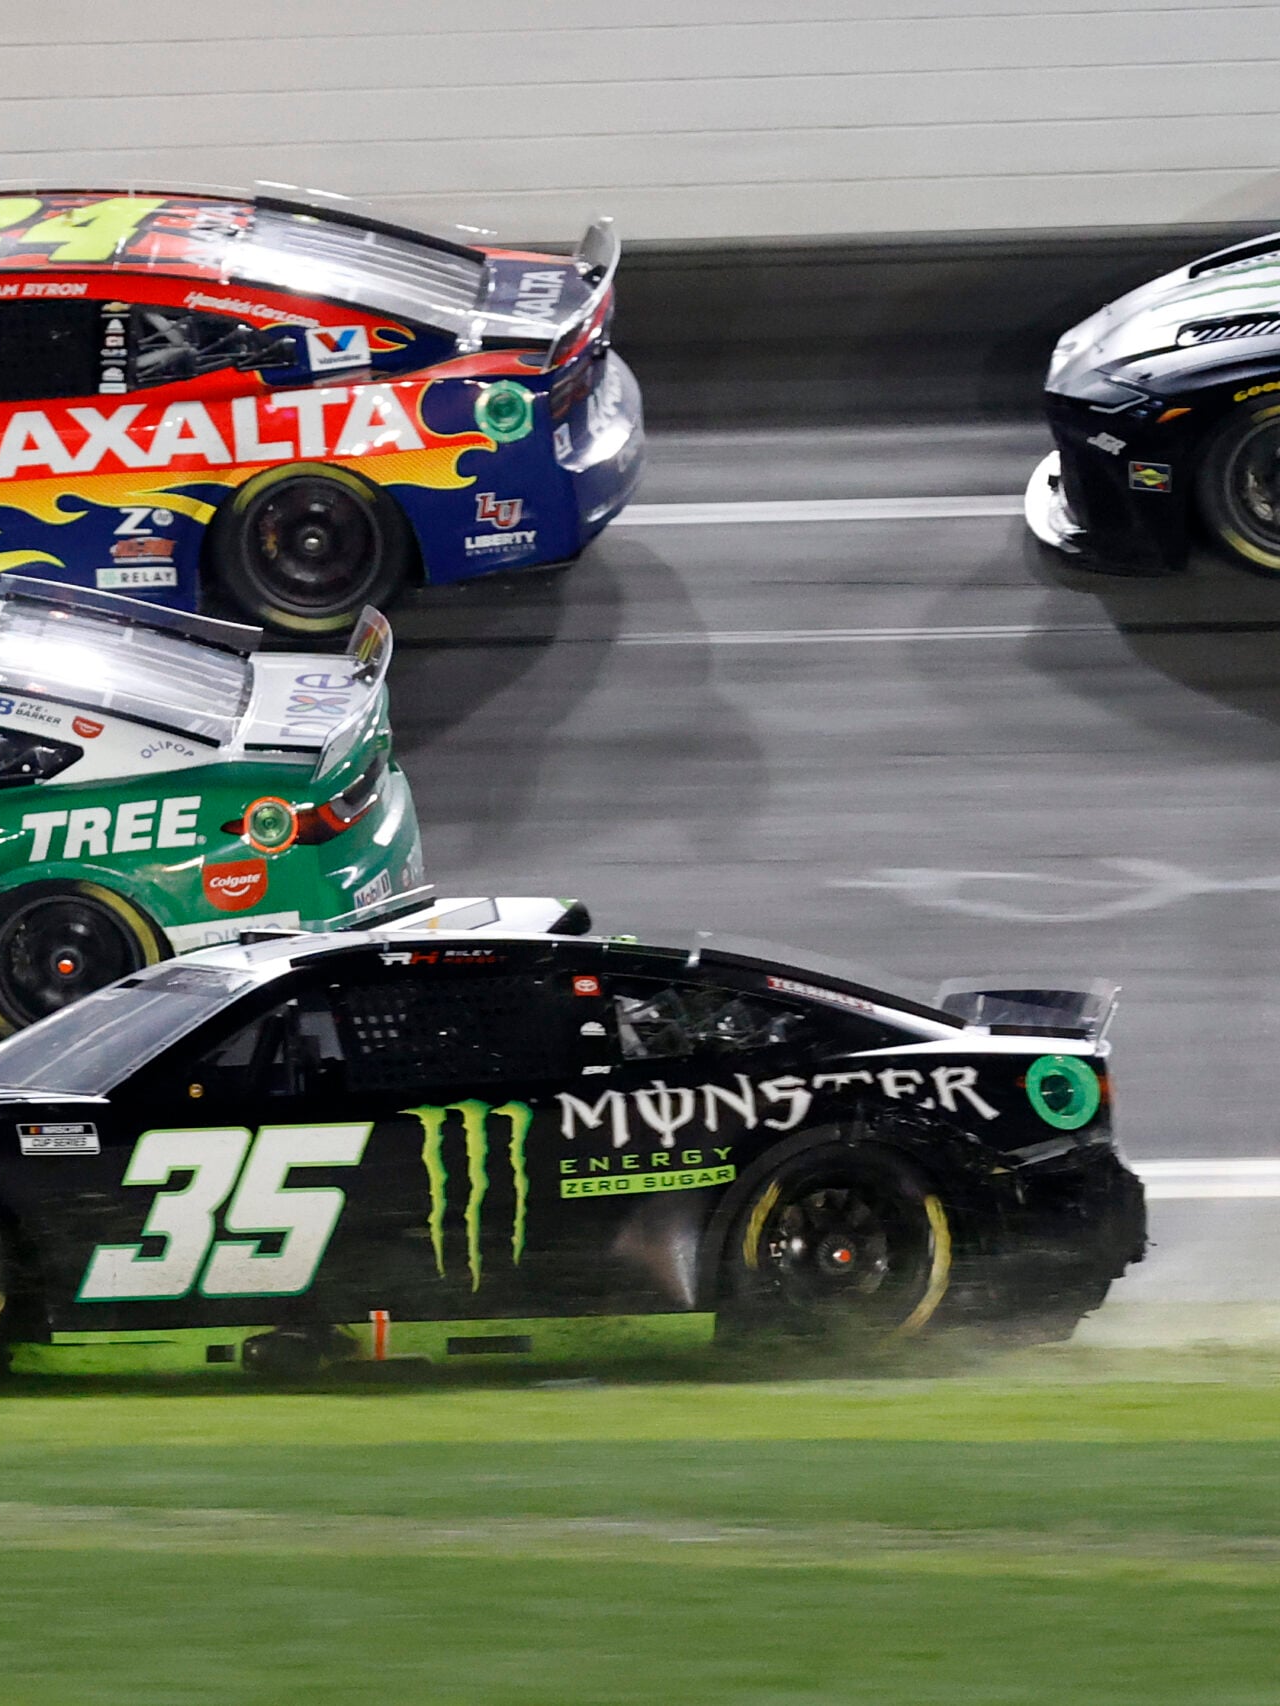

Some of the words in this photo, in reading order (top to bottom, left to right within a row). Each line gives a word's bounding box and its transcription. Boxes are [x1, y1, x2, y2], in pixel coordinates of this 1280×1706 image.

[21, 283, 89, 297] BYRON
[465, 531, 537, 550] LIBERTY
[120, 572, 172, 583] RELAY
[15, 708, 62, 725] BARKER
[140, 741, 195, 760] OLIPOP
[22, 796, 202, 862] TREE
[209, 873, 262, 889] Colgate
[53, 1137, 88, 1147] SERIES
[559, 1146, 733, 1175] ENERGY
[566, 1179, 630, 1195] ZERO
[643, 1168, 732, 1189] SUGAR
[74, 1121, 375, 1303] 35
